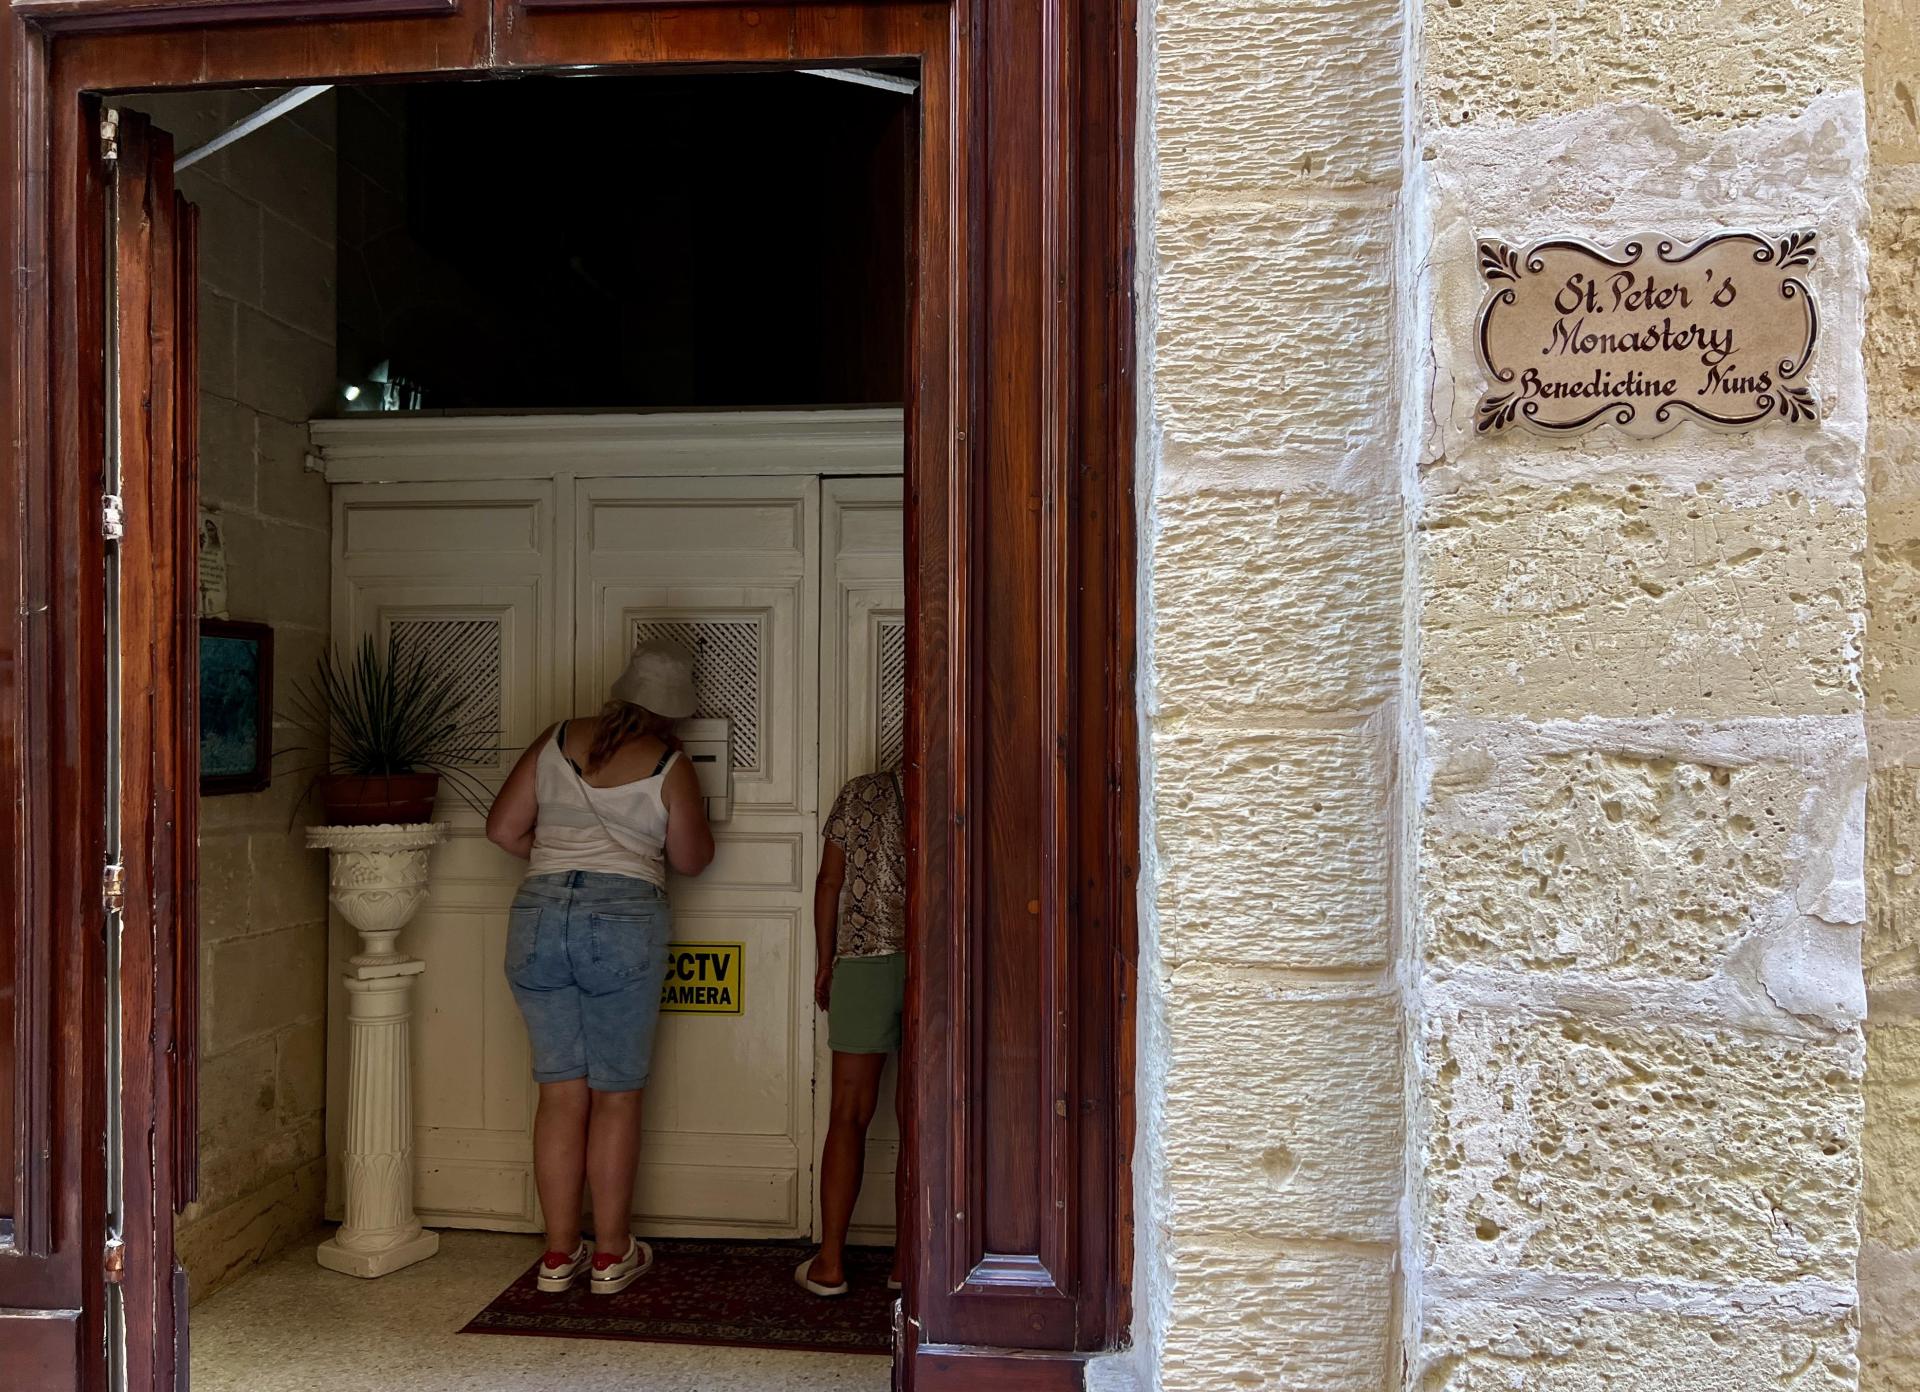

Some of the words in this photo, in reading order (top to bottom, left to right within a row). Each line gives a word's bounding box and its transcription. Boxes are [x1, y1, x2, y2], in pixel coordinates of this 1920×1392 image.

[1542, 316, 1739, 366] Monastery
[1520, 367, 1677, 399] Benedictine
[1697, 365, 1772, 395] Nuns
